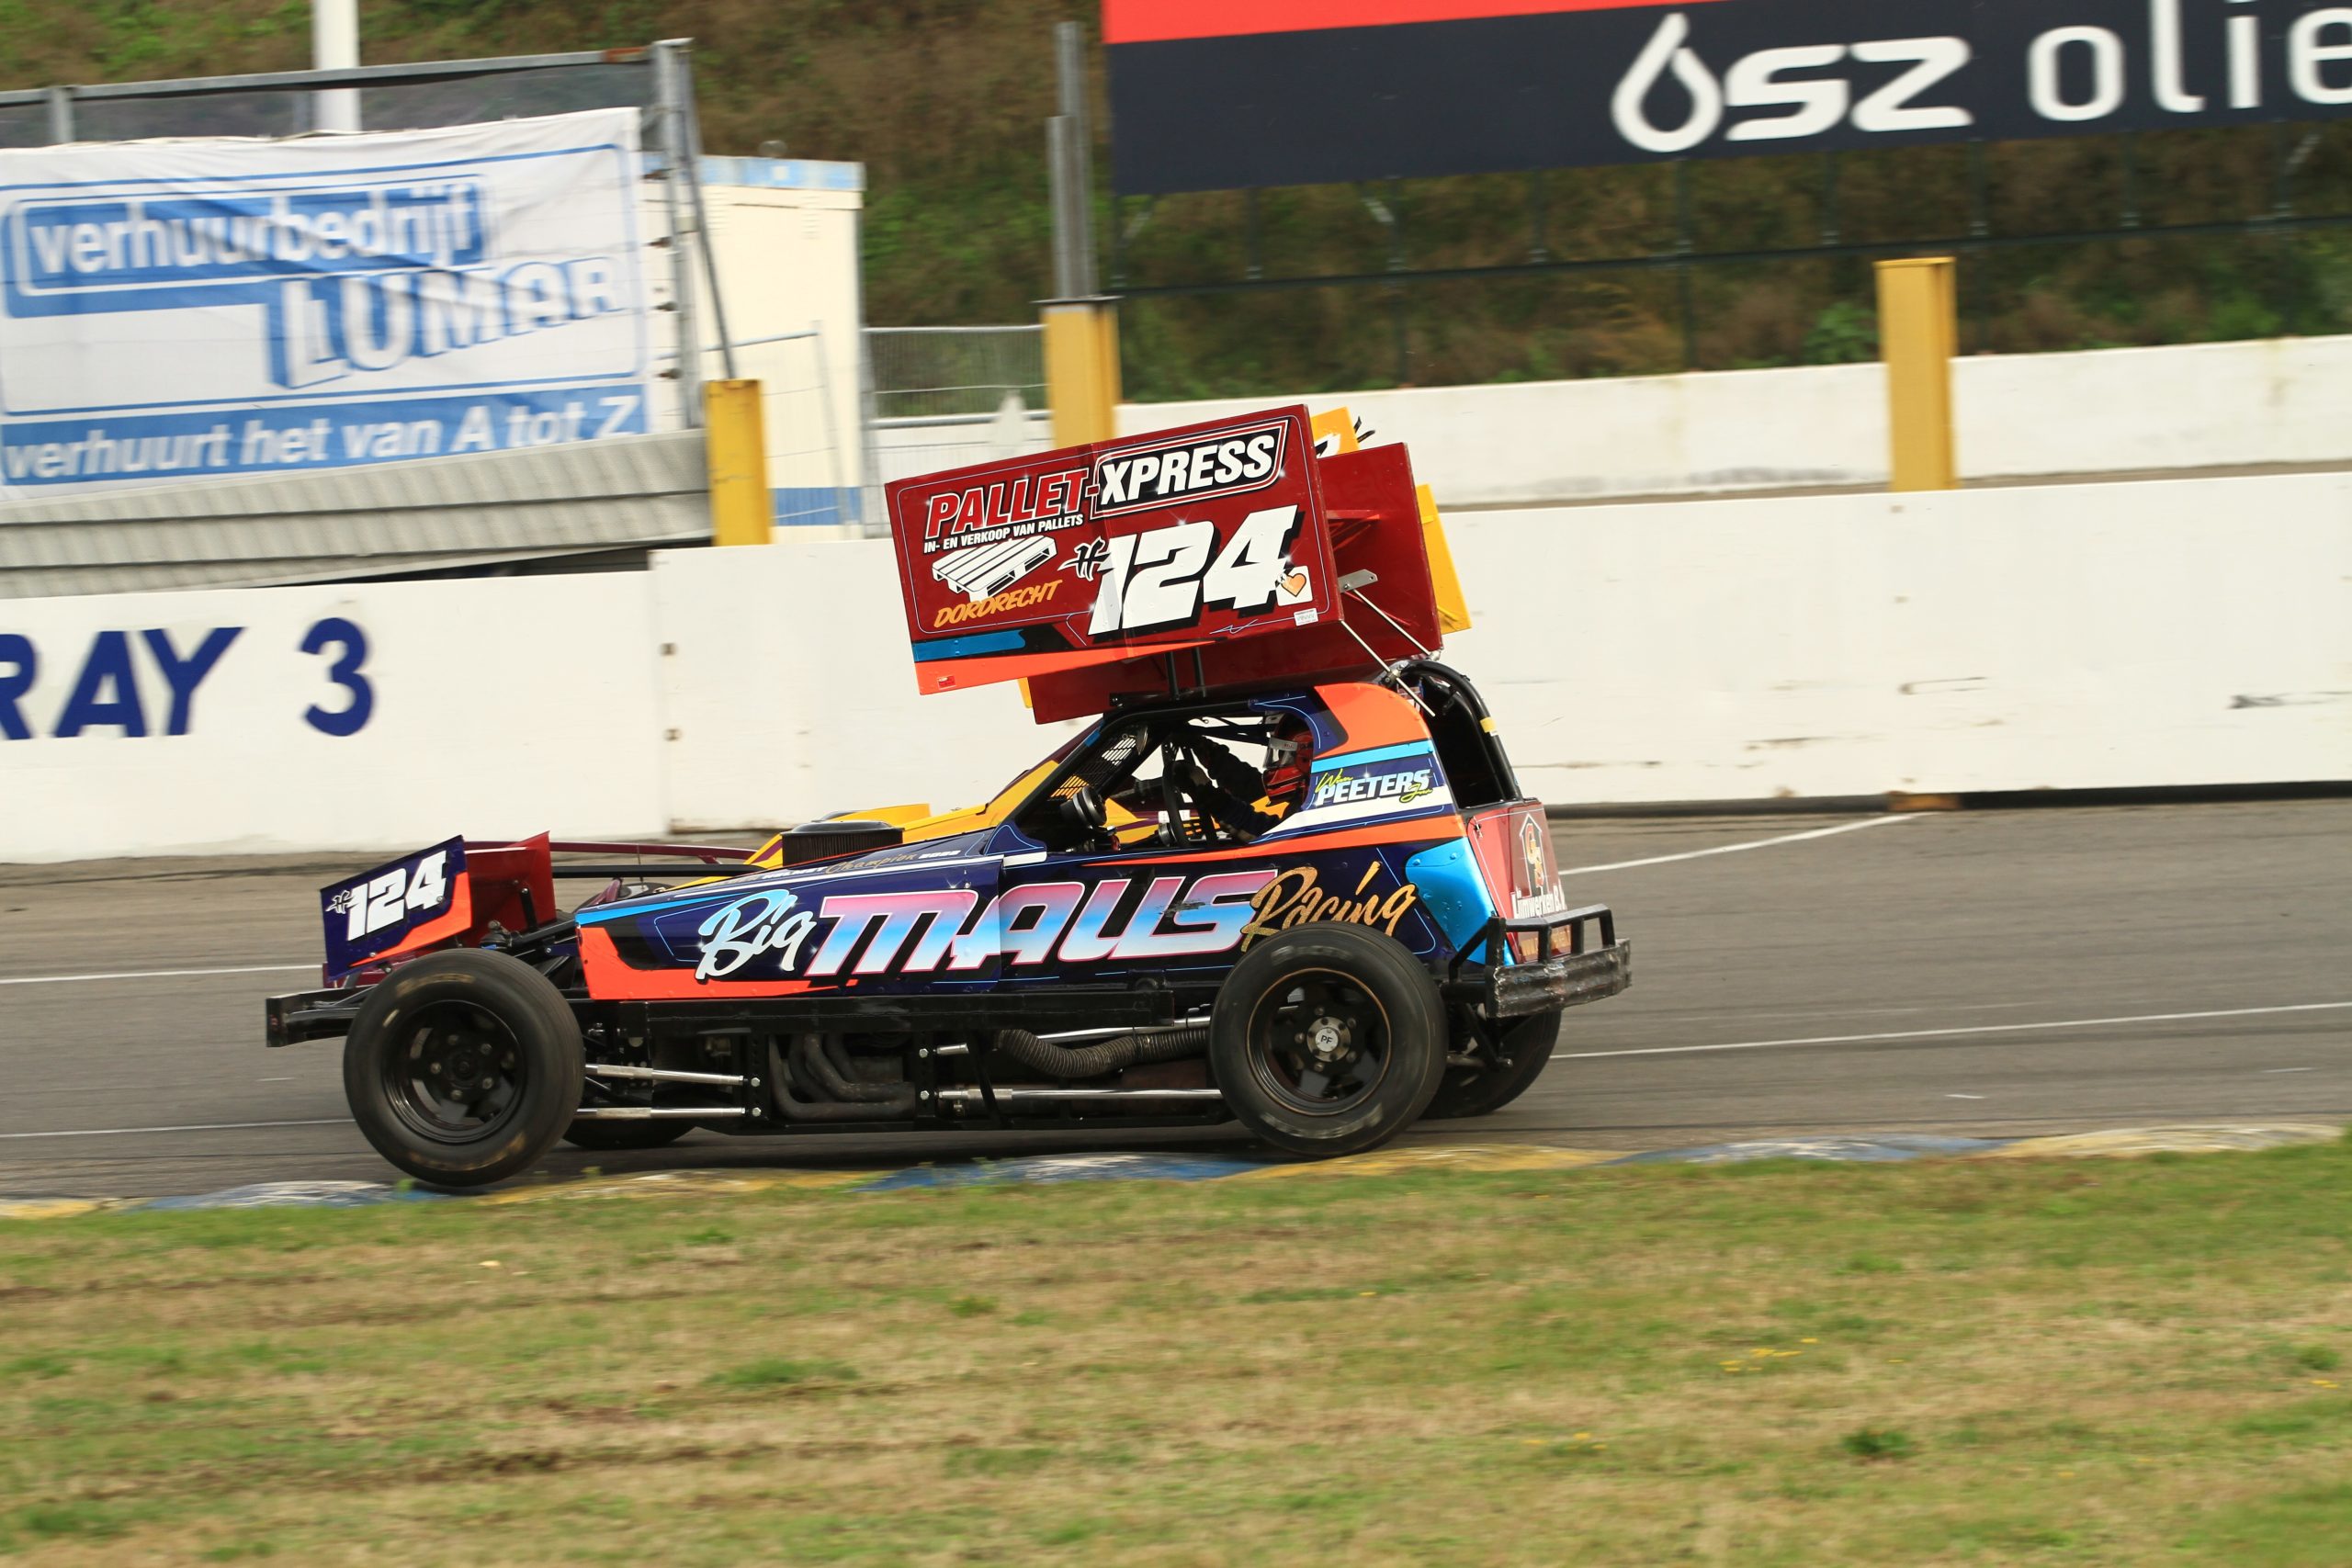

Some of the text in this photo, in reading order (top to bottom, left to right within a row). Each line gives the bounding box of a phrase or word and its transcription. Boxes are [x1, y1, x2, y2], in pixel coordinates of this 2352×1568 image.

[29, 182, 476, 275] verhuurbedrijf
[278, 255, 623, 389] LUMAR
[4, 395, 639, 479] verhuurt het van A tot Z
[923, 513, 1084, 554] IN- EN VERKOOP VAN PALLETS
[933, 580, 1063, 627] DORDRECHT
[298, 617, 376, 737] 3
[1315, 769, 1431, 806] PEETERS
[825, 853, 918, 874] Champion
[695, 888, 817, 980] Big
[1240, 861, 1419, 953] Racing
[1321, 1035, 1332, 1043] PF
